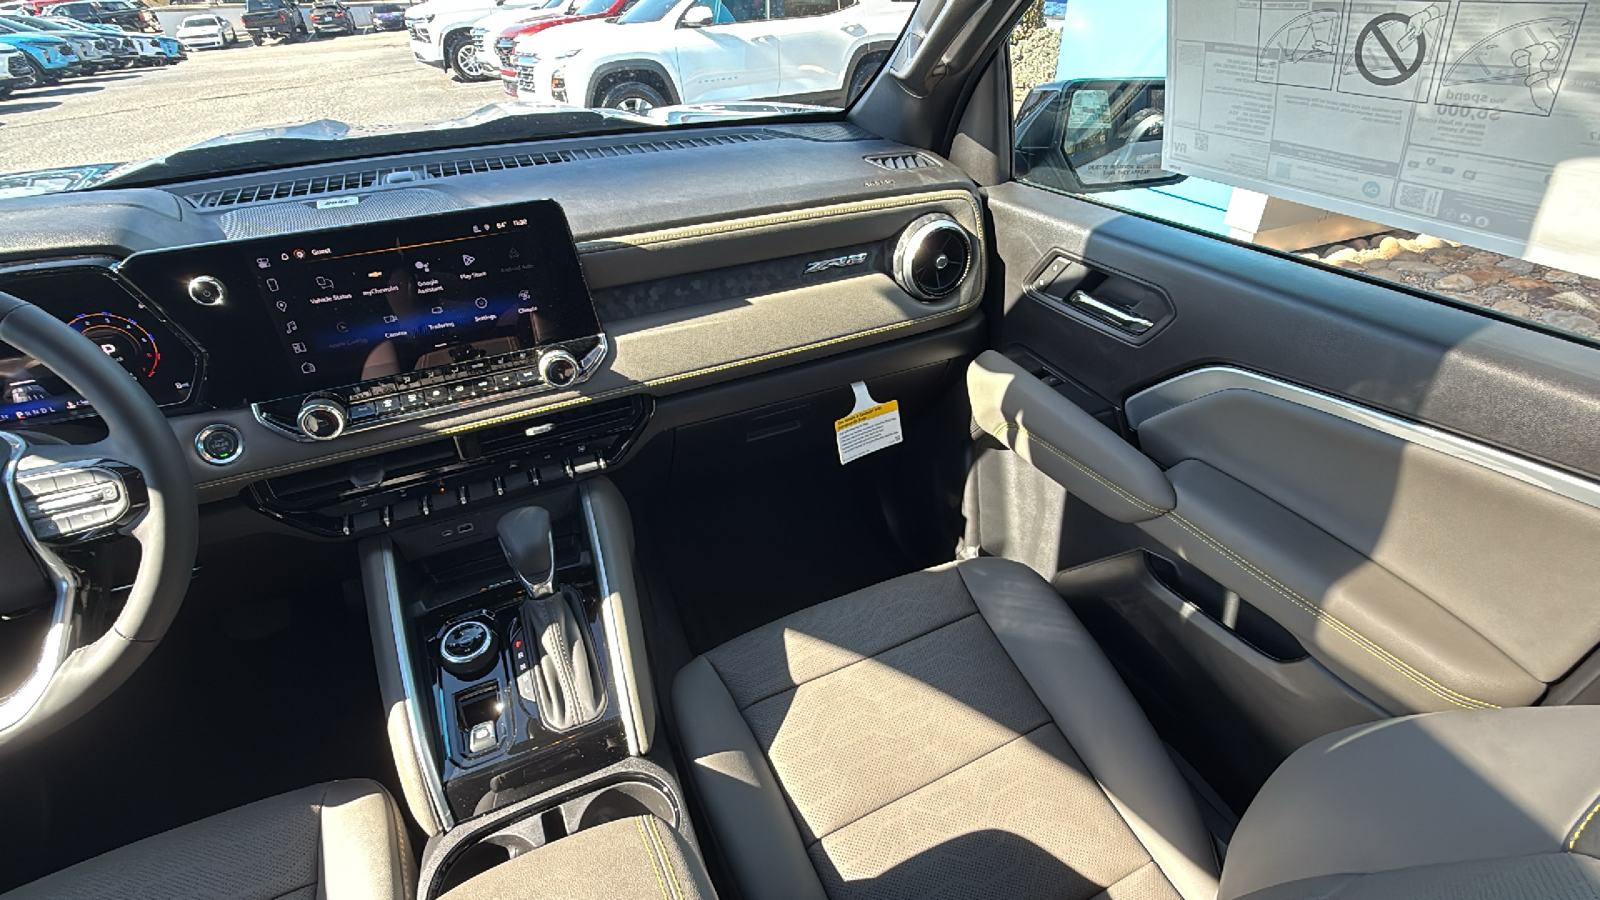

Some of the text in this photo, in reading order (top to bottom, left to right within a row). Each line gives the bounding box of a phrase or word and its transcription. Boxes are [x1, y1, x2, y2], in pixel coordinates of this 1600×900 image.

[311, 247, 332, 256] Guest
[417, 279, 439, 287] Google
[333, 293, 353, 301] Status
